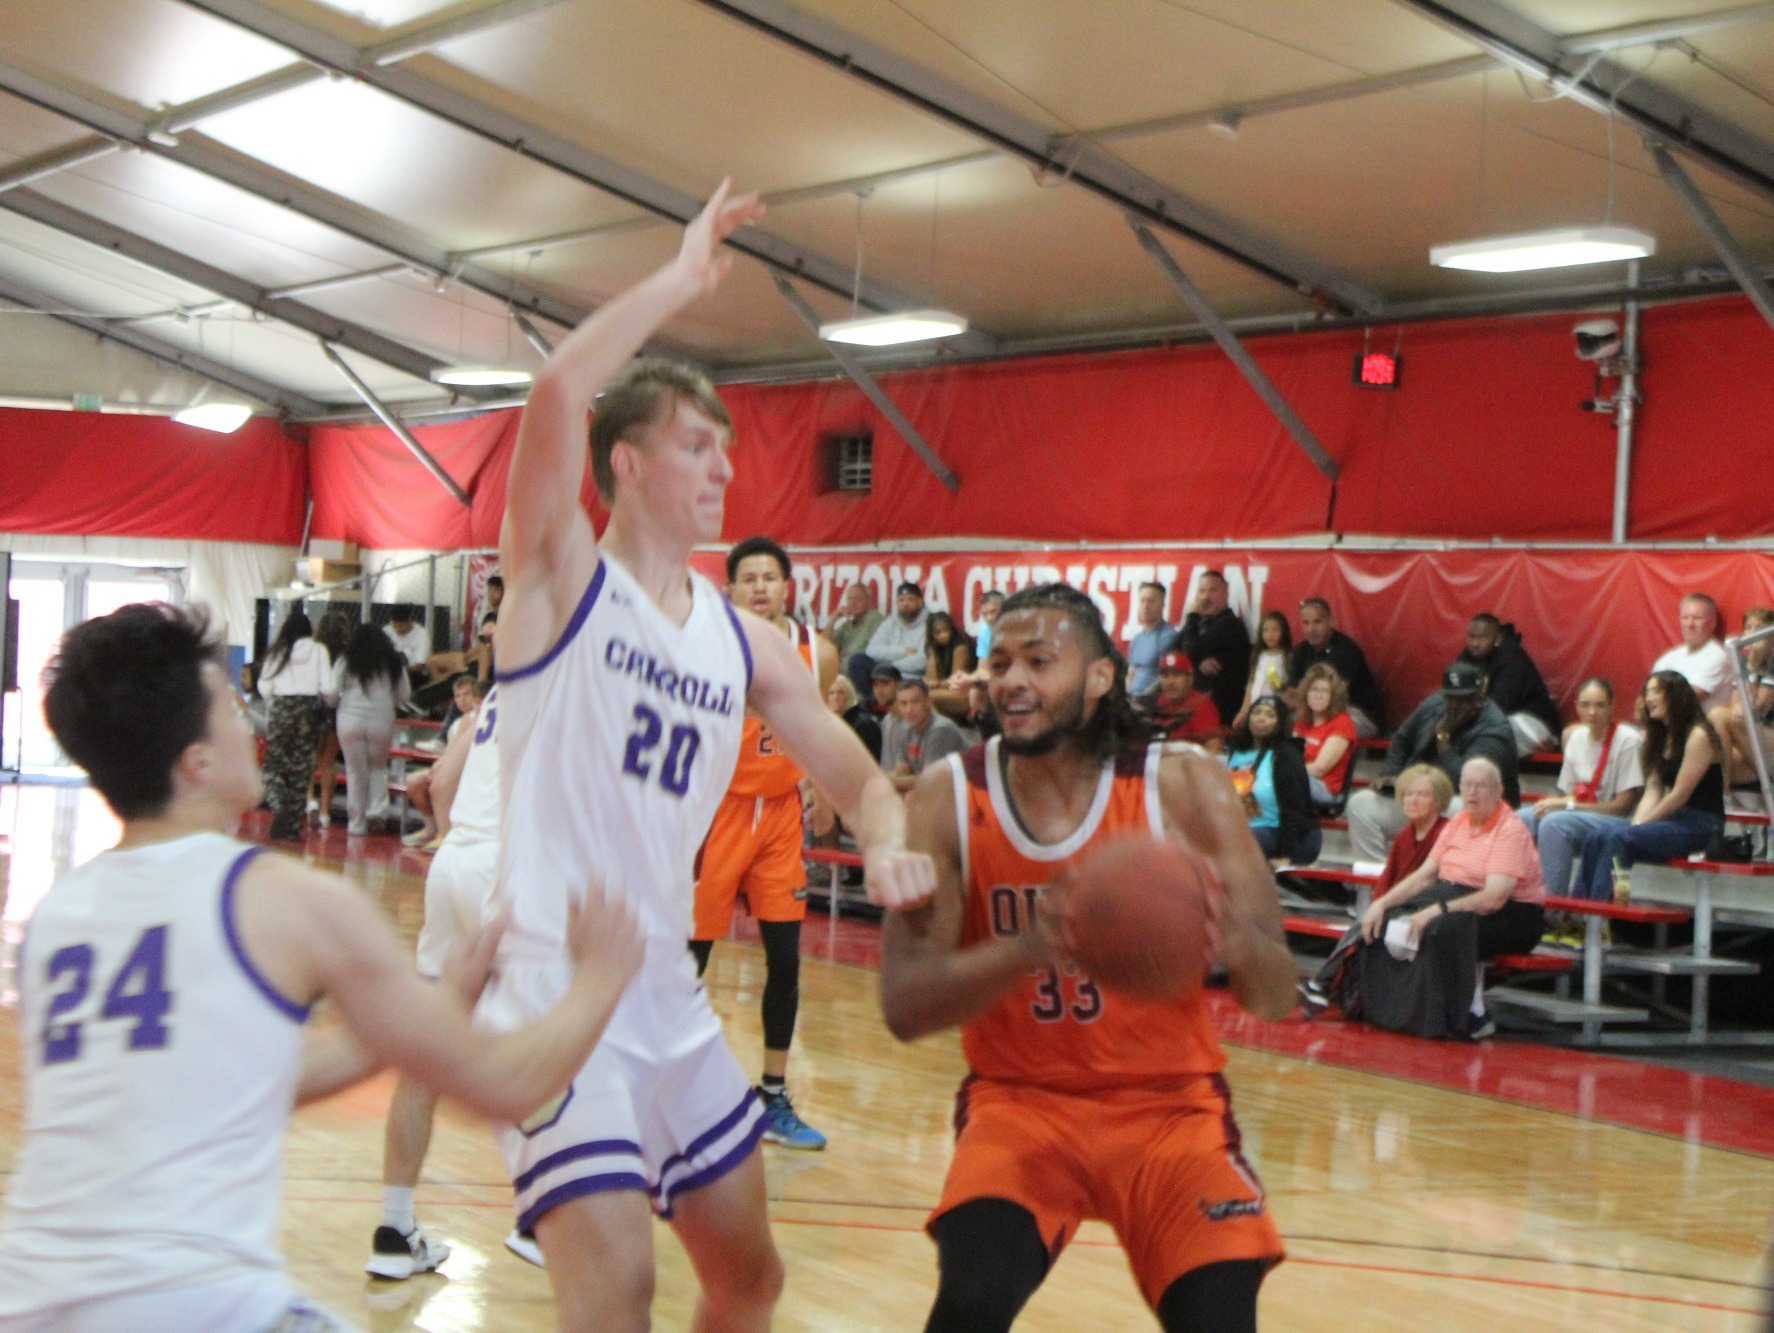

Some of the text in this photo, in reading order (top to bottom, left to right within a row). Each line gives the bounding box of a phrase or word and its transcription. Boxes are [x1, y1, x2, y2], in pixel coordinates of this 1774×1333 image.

[787, 563, 1269, 641] RIZONA CSTIAN
[622, 702, 700, 797] 20
[42, 924, 172, 1066] 24
